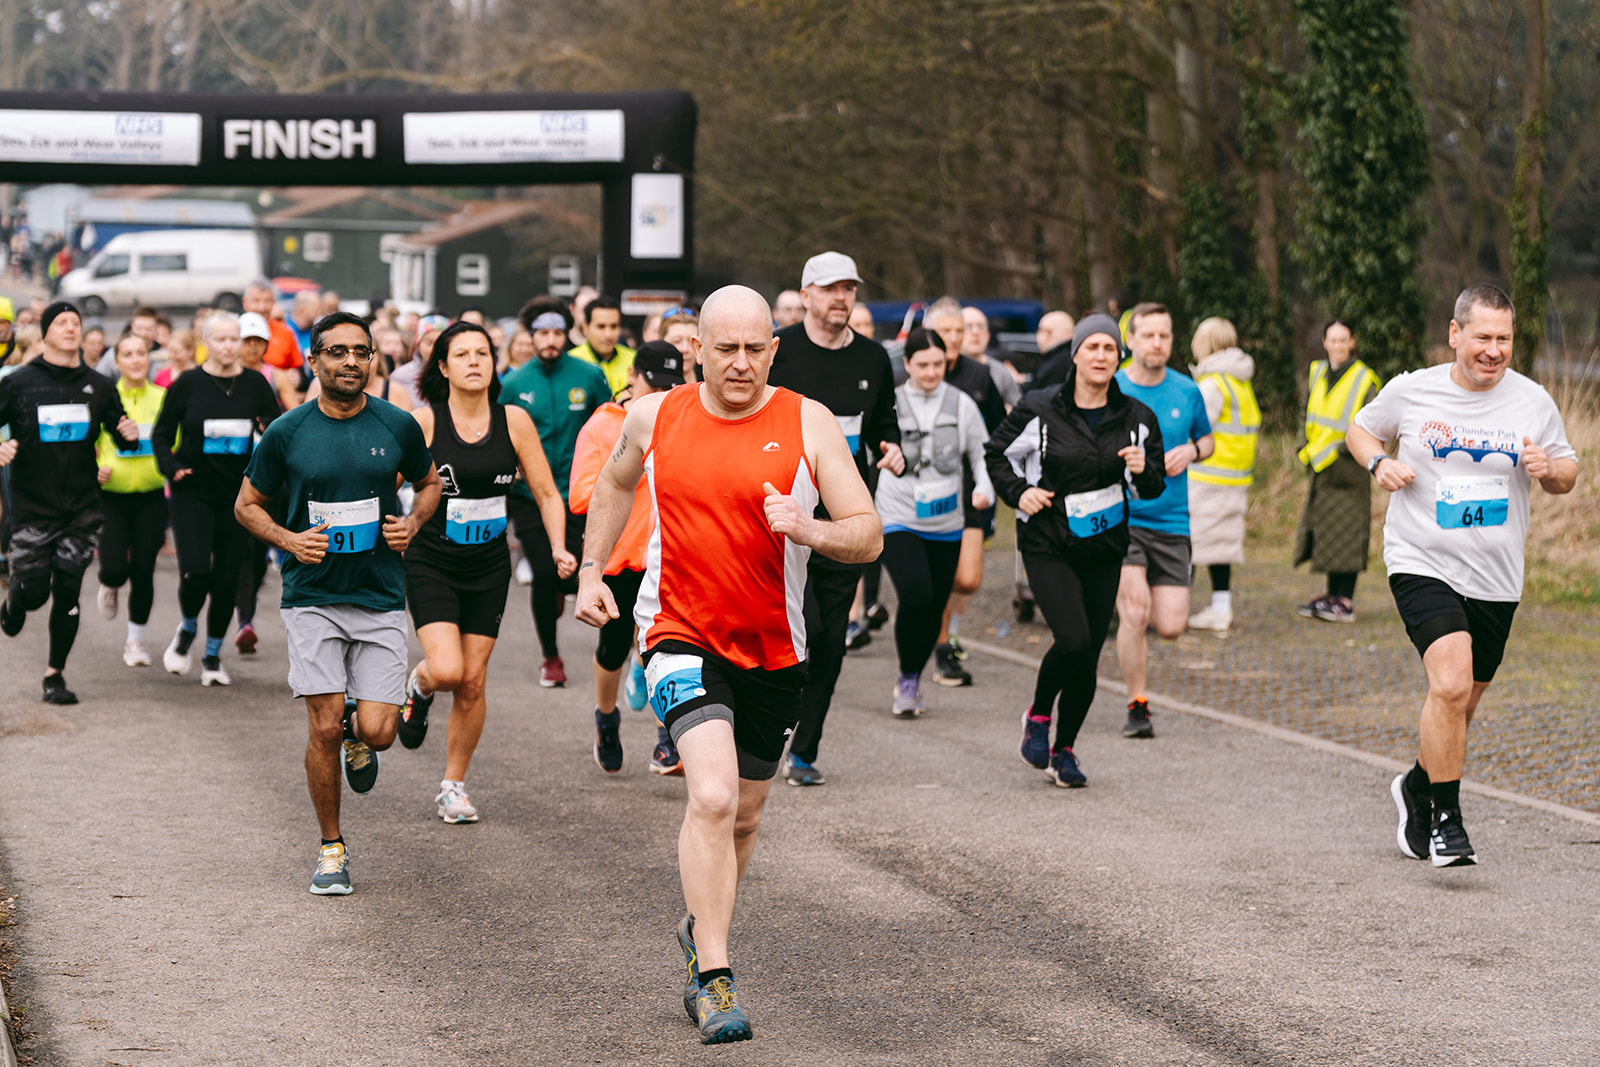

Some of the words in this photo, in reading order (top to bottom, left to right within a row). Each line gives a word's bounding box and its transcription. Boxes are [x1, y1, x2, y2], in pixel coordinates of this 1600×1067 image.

[224, 118, 376, 160] FINISH
[1453, 424, 1495, 437] Clumber
[1497, 429, 1517, 438] Park
[1441, 490, 1455, 500] 5k
[314, 515, 326, 525] 5k
[451, 511, 463, 520] 5k
[1090, 513, 1108, 532] 36
[1462, 506, 1484, 526] 64
[333, 531, 354, 551] 91
[465, 524, 490, 542] 116
[655, 680, 679, 717] 152
